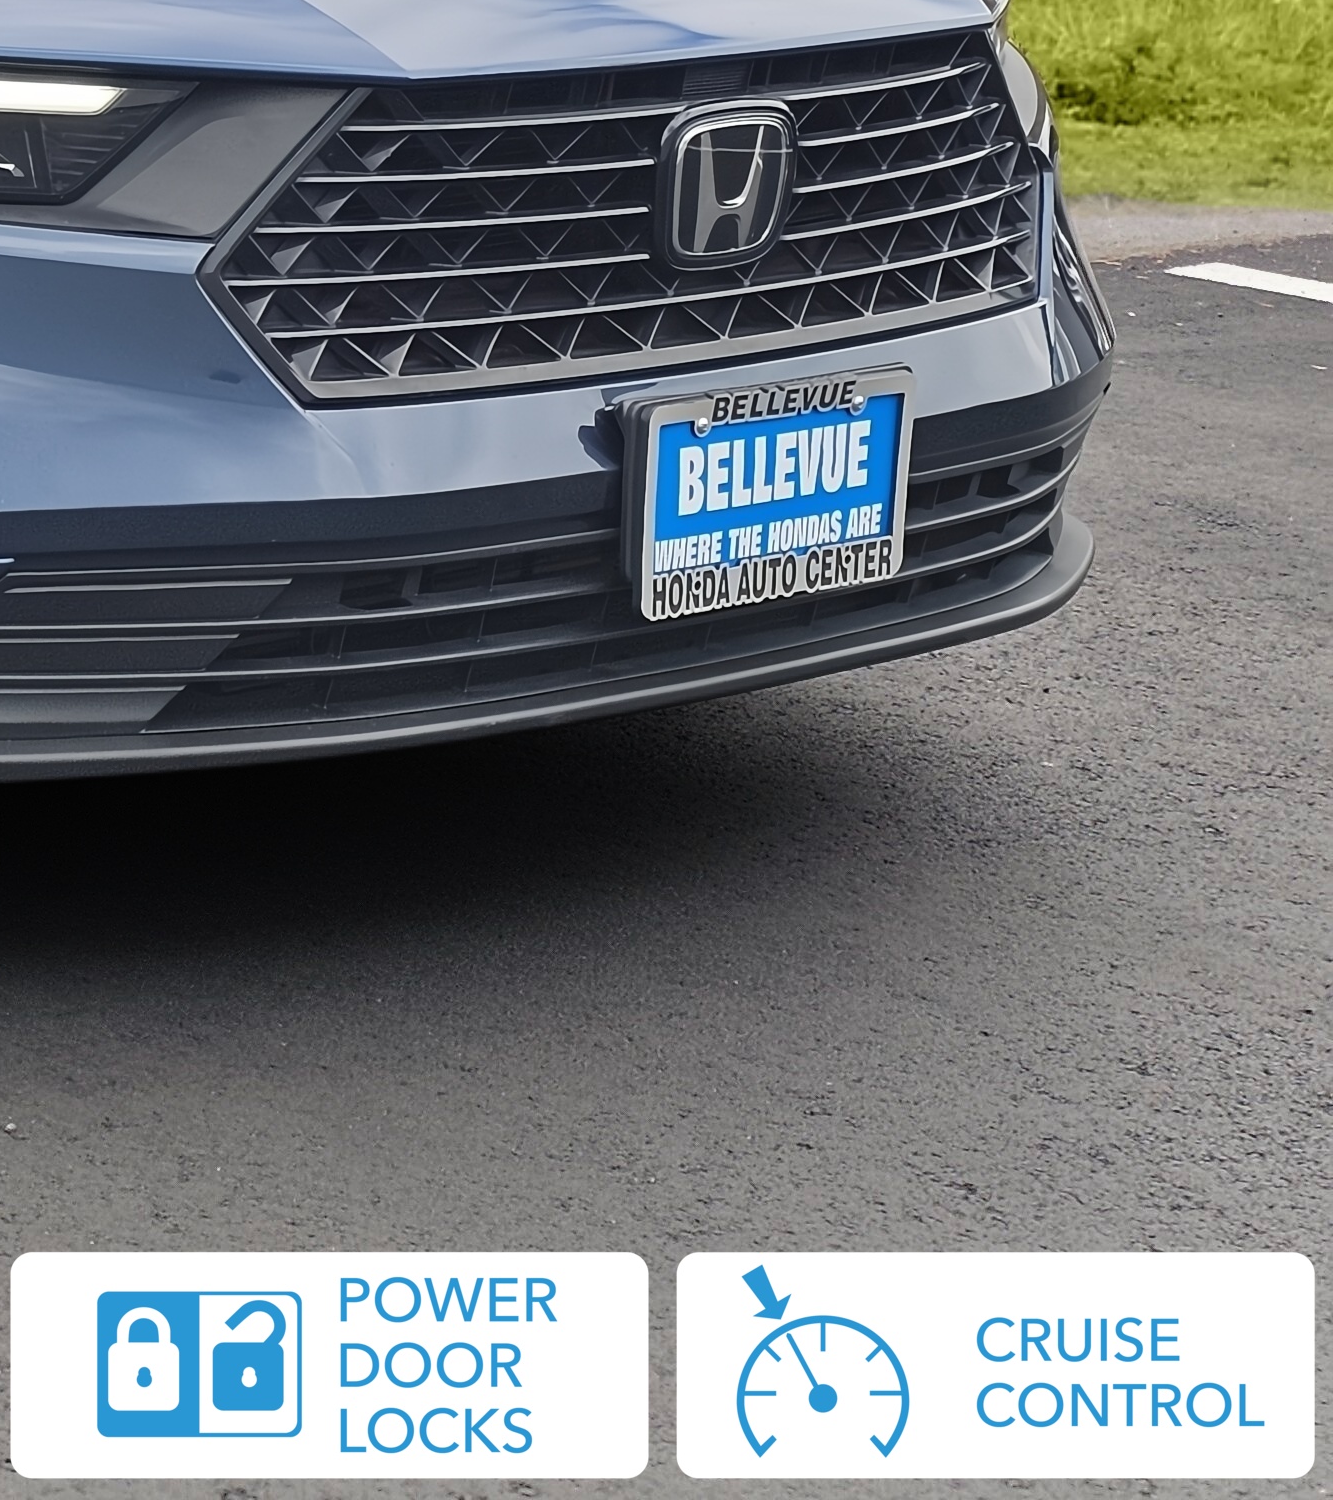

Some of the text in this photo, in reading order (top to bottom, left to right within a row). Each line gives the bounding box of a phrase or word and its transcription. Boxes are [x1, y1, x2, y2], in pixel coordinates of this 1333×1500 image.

[711, 380, 857, 423] BELLEVUE
[678, 419, 872, 517] BELLEVUE
[653, 502, 883, 573] WHERE THE HONDAS ARE
[652, 539, 893, 618] HONDA AUTO CENTER
